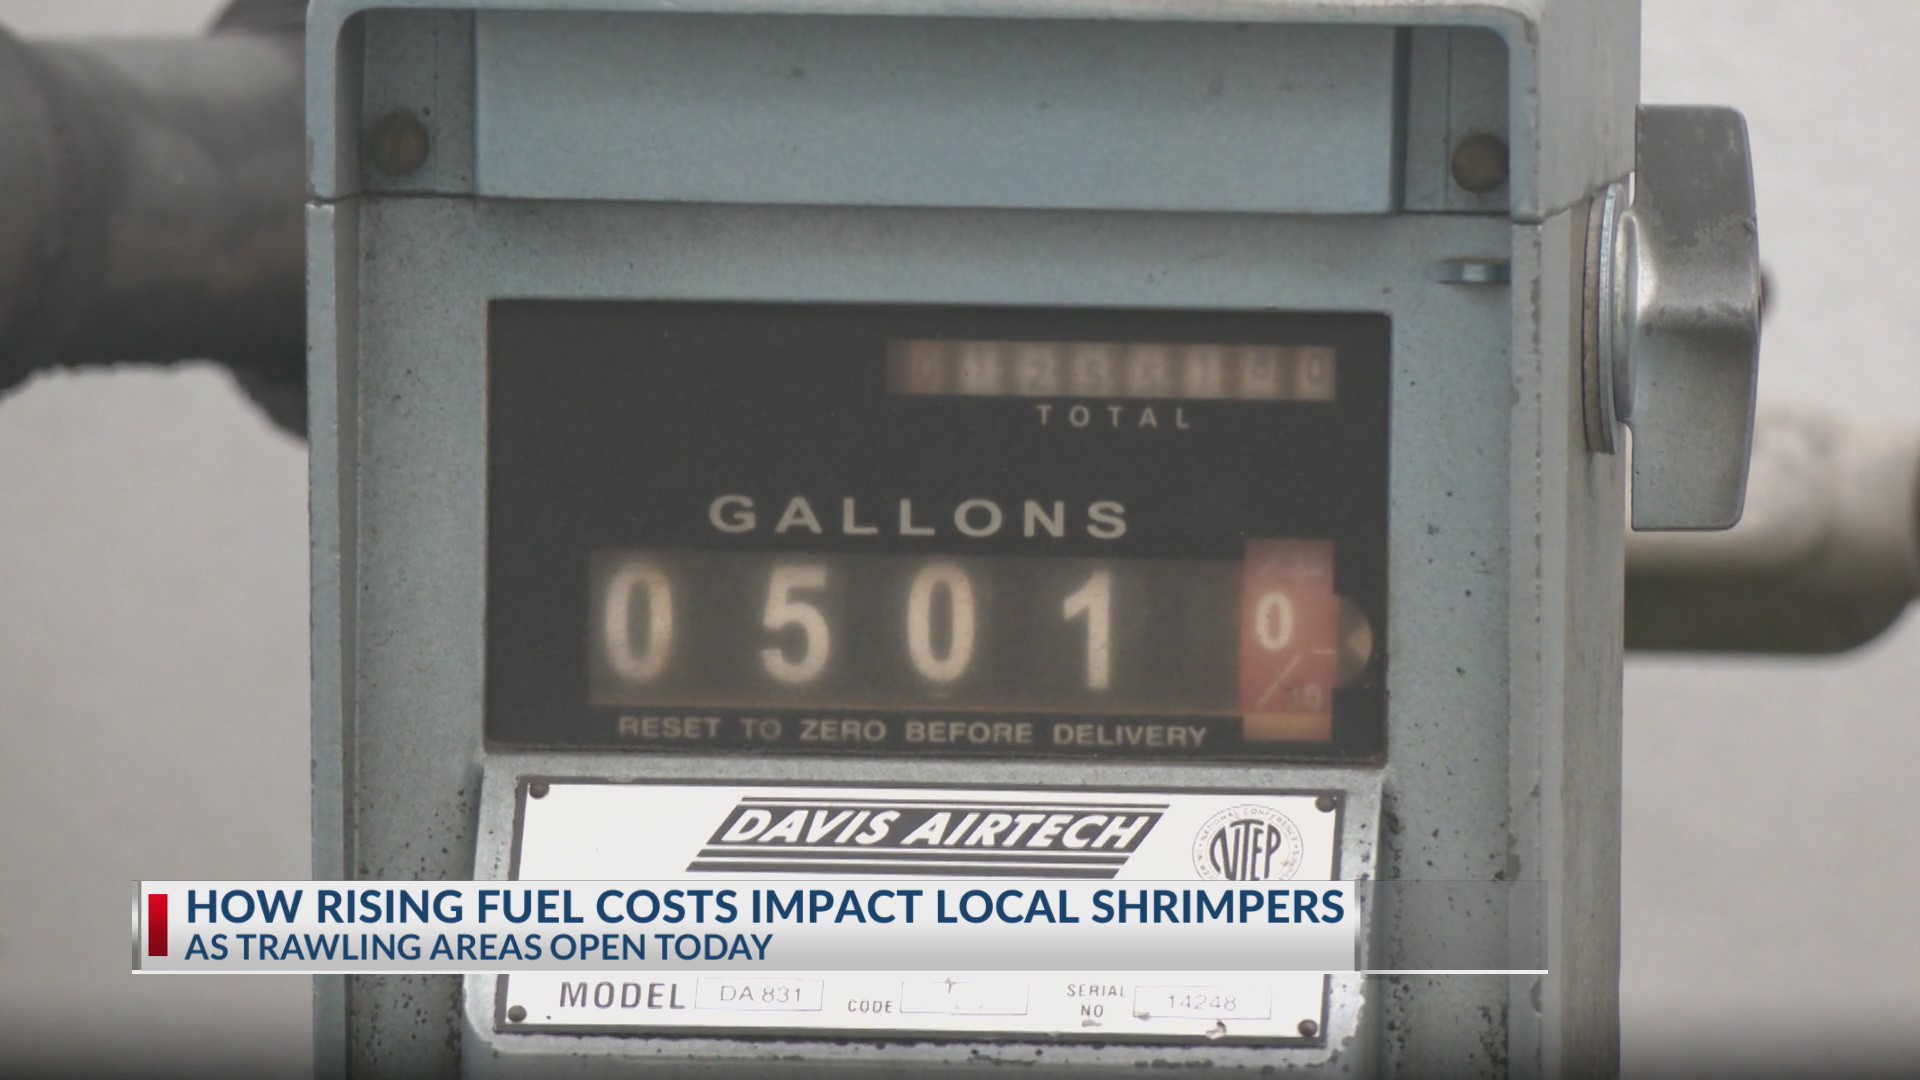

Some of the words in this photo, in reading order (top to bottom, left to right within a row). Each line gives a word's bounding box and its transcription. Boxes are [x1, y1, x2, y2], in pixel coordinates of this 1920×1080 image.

[1037, 404, 1192, 428] TOTAL
[708, 494, 1128, 539] GALLONS
[618, 716, 721, 739] RESET
[740, 718, 782, 740] TO
[800, 719, 887, 741] ZERO
[904, 721, 1033, 744] BEFORE
[1052, 723, 1207, 747] DELIVERY
[720, 808, 900, 846] DAVIS
[900, 811, 1150, 849] AIRTECH
[559, 981, 686, 1010] MODEL
[1067, 983, 1126, 998] SERIAL
[848, 1000, 893, 1014] CODE
[1080, 1004, 1105, 1018] NO
[1167, 994, 1238, 1011] 14248
